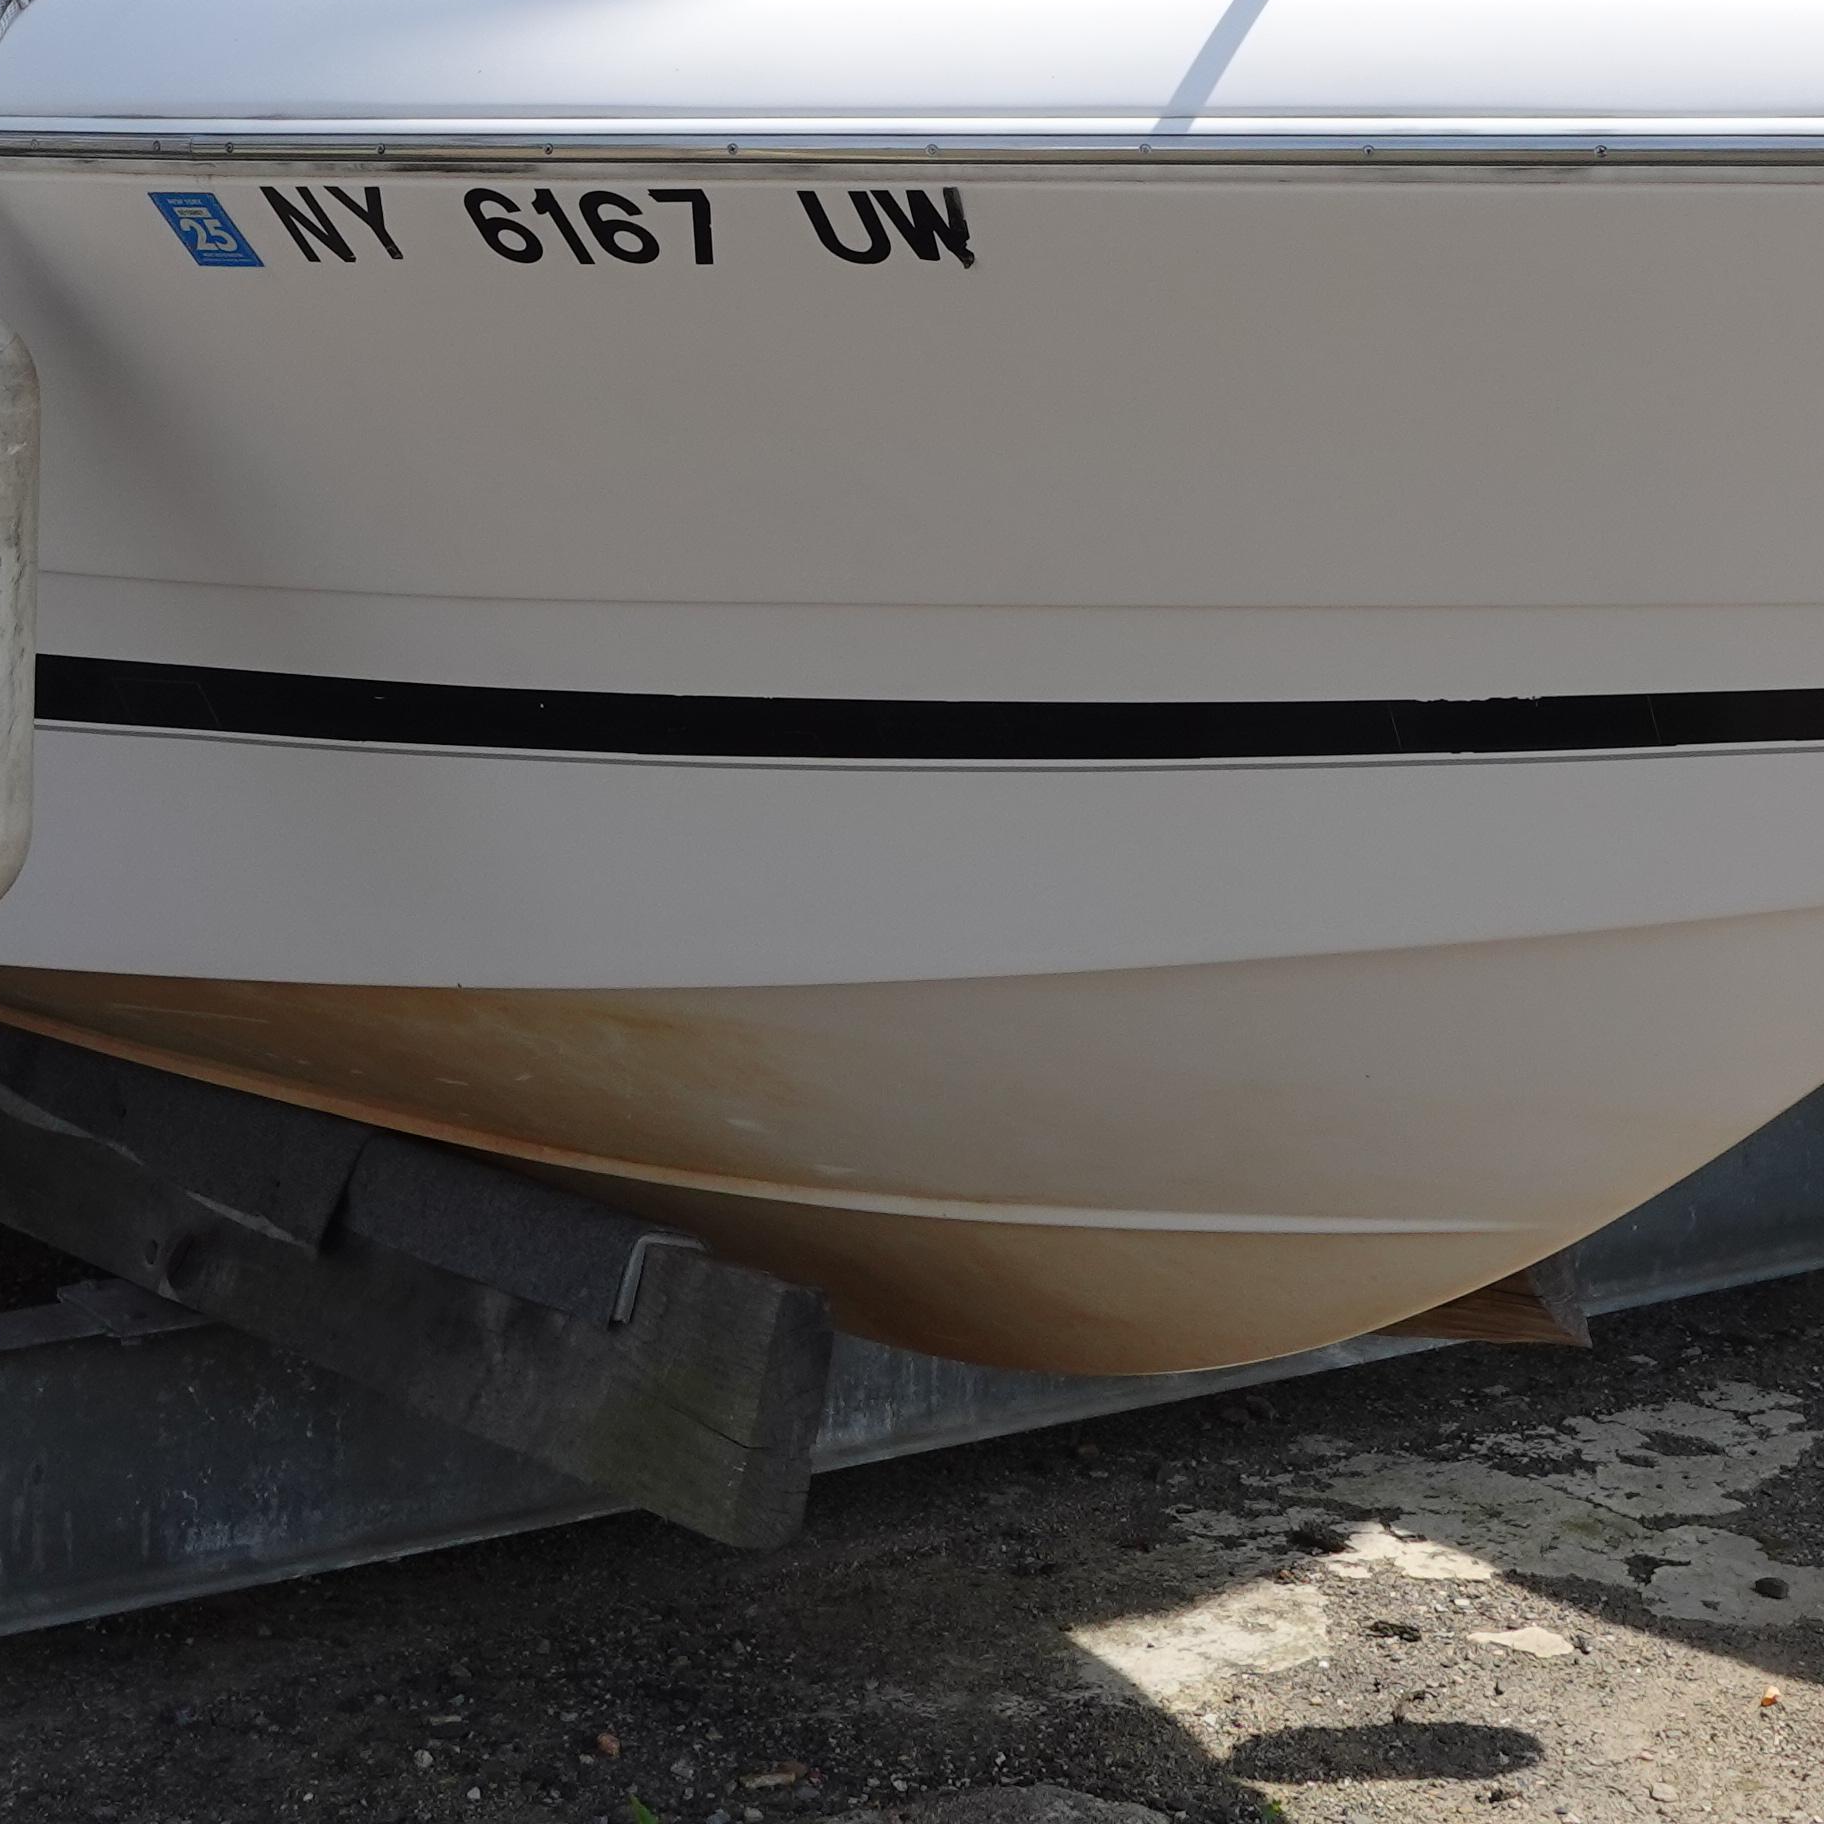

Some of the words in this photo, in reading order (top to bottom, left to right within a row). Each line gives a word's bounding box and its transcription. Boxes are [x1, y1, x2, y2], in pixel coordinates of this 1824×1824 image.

[179, 217, 238, 253] 25
[259, 186, 404, 263] NY
[464, 188, 714, 265] 6167
[796, 187, 975, 269] UW
